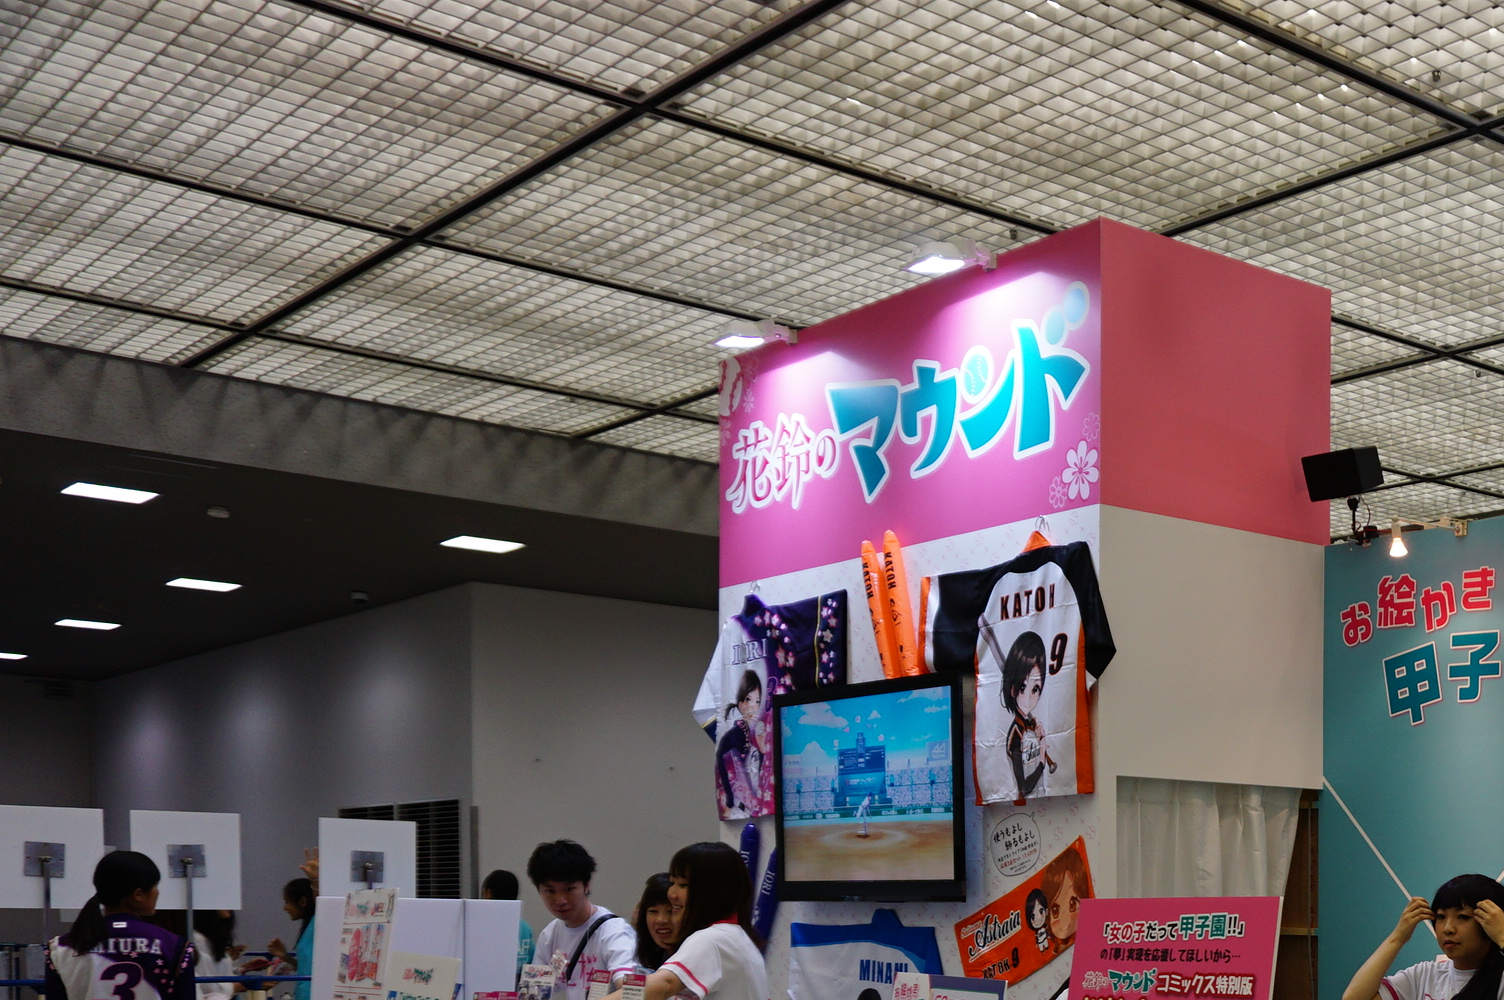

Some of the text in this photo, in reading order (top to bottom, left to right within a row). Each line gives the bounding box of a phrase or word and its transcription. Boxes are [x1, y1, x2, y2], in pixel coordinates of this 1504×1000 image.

[726, 281, 1091, 515] 花鈴のマウンド
[1000, 583, 1056, 621] KATOH
[1340, 566, 1496, 646] お絵かき
[1049, 632, 1068, 675] 9
[762, 871, 776, 895] IORI
